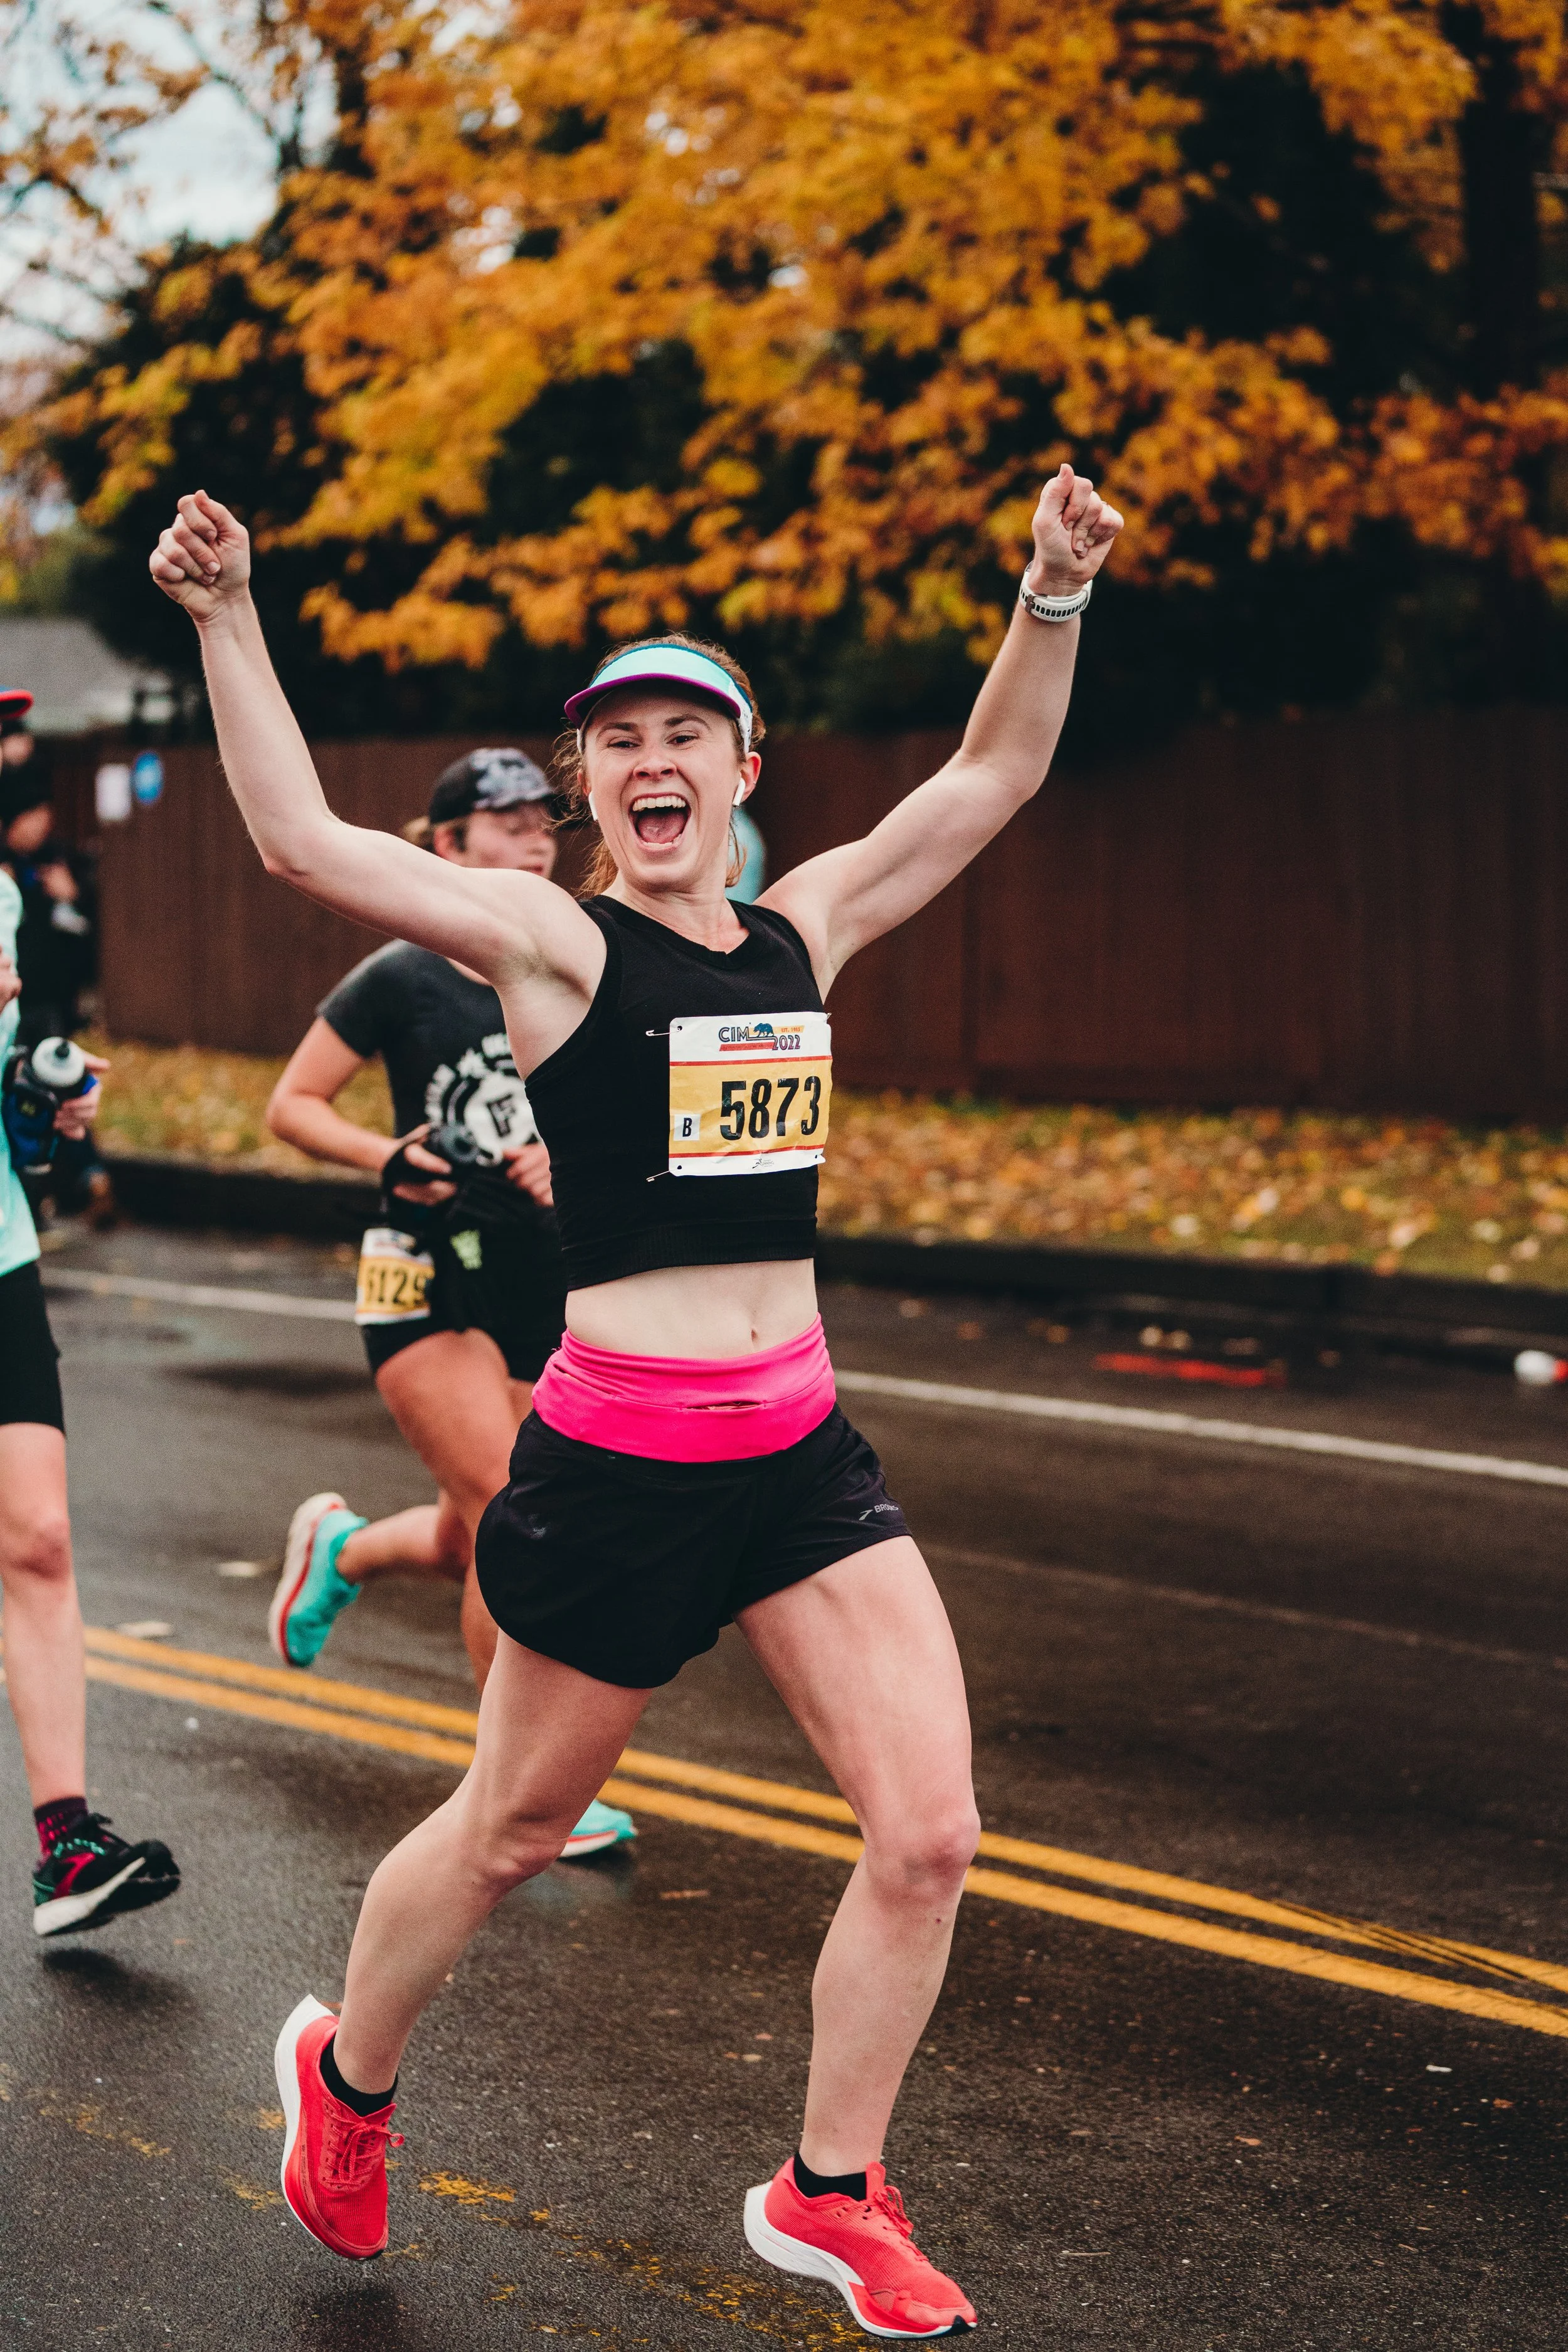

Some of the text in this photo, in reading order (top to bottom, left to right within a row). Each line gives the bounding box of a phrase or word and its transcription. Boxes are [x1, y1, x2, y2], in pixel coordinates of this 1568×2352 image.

[718, 1026, 750, 1042] CIM
[772, 1035, 801, 1051] 2022
[720, 1076, 821, 1141] 5873
[682, 1117, 692, 1137] B
